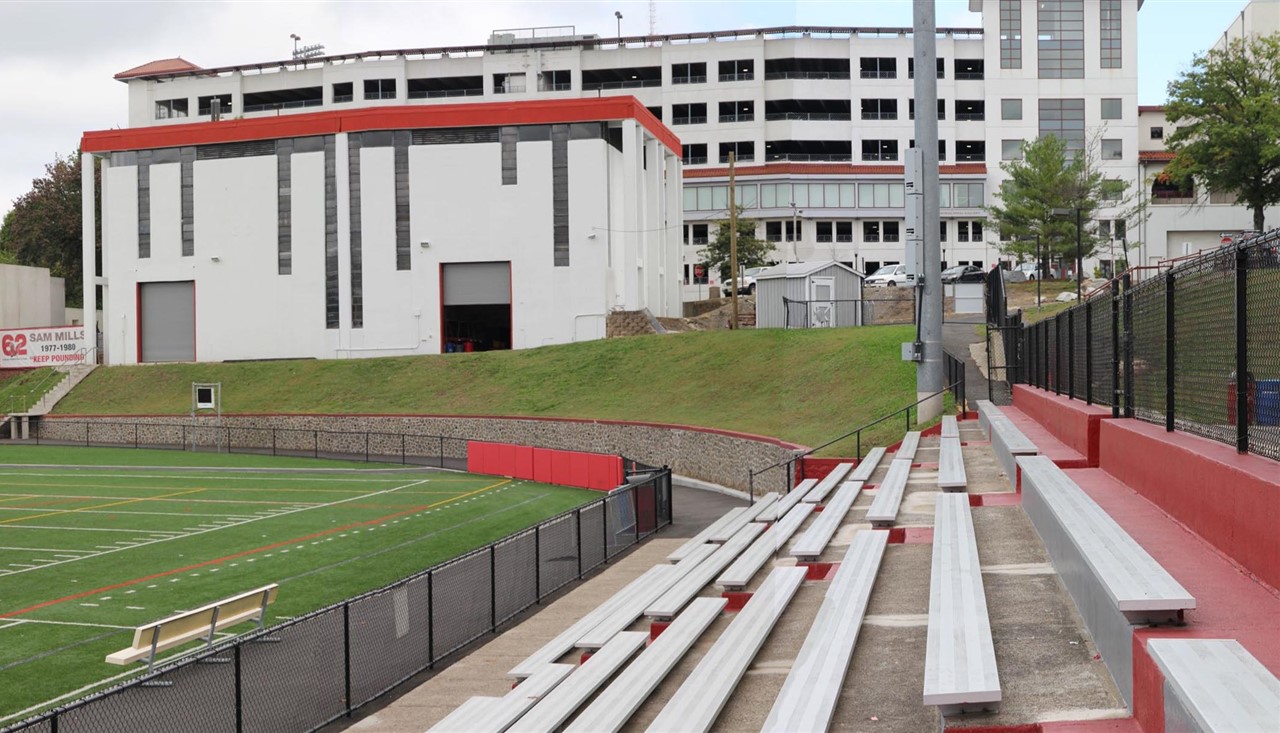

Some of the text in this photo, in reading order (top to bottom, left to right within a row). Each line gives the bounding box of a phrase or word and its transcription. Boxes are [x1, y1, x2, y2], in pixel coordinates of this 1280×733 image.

[29, 331, 84, 342] SAM MILLS
[2, 333, 27, 357] 62
[41, 343, 76, 352] 1977-1980
